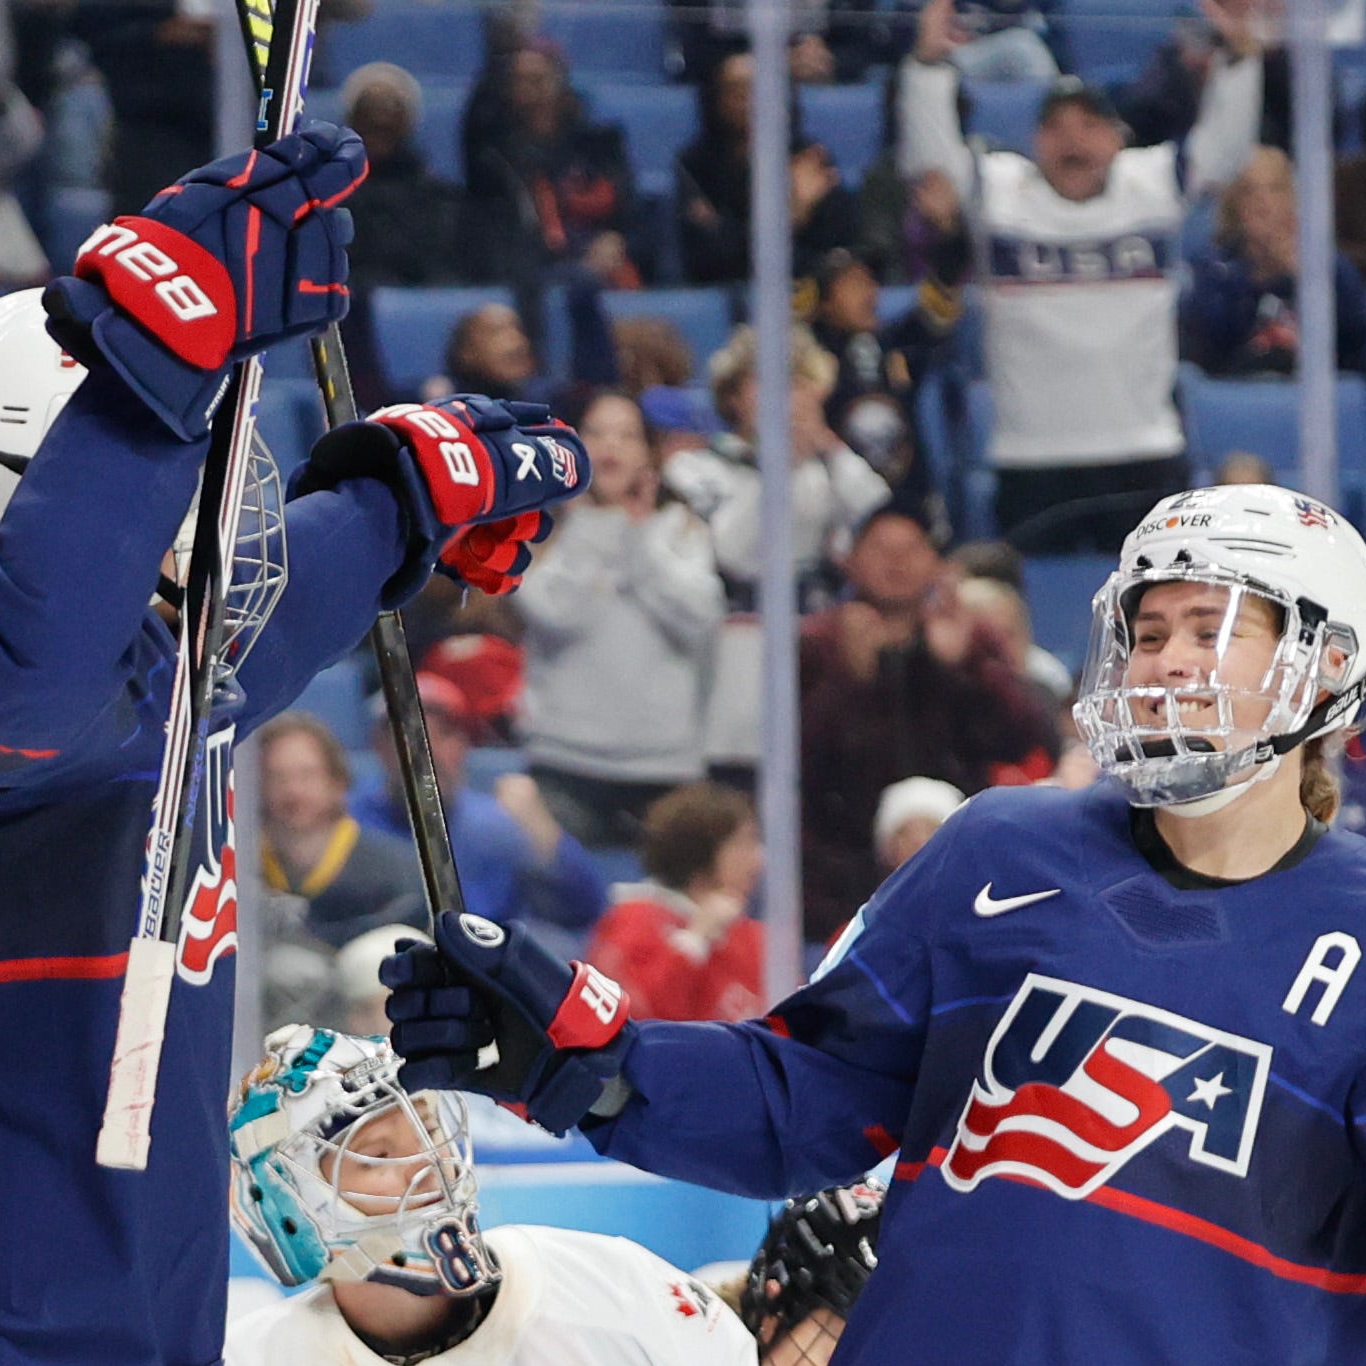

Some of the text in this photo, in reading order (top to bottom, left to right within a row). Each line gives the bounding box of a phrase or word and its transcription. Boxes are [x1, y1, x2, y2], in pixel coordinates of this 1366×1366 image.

[1136, 513, 1212, 540] DISCOVER
[1282, 930, 1362, 1028] A
[941, 972, 1275, 1200] USA
